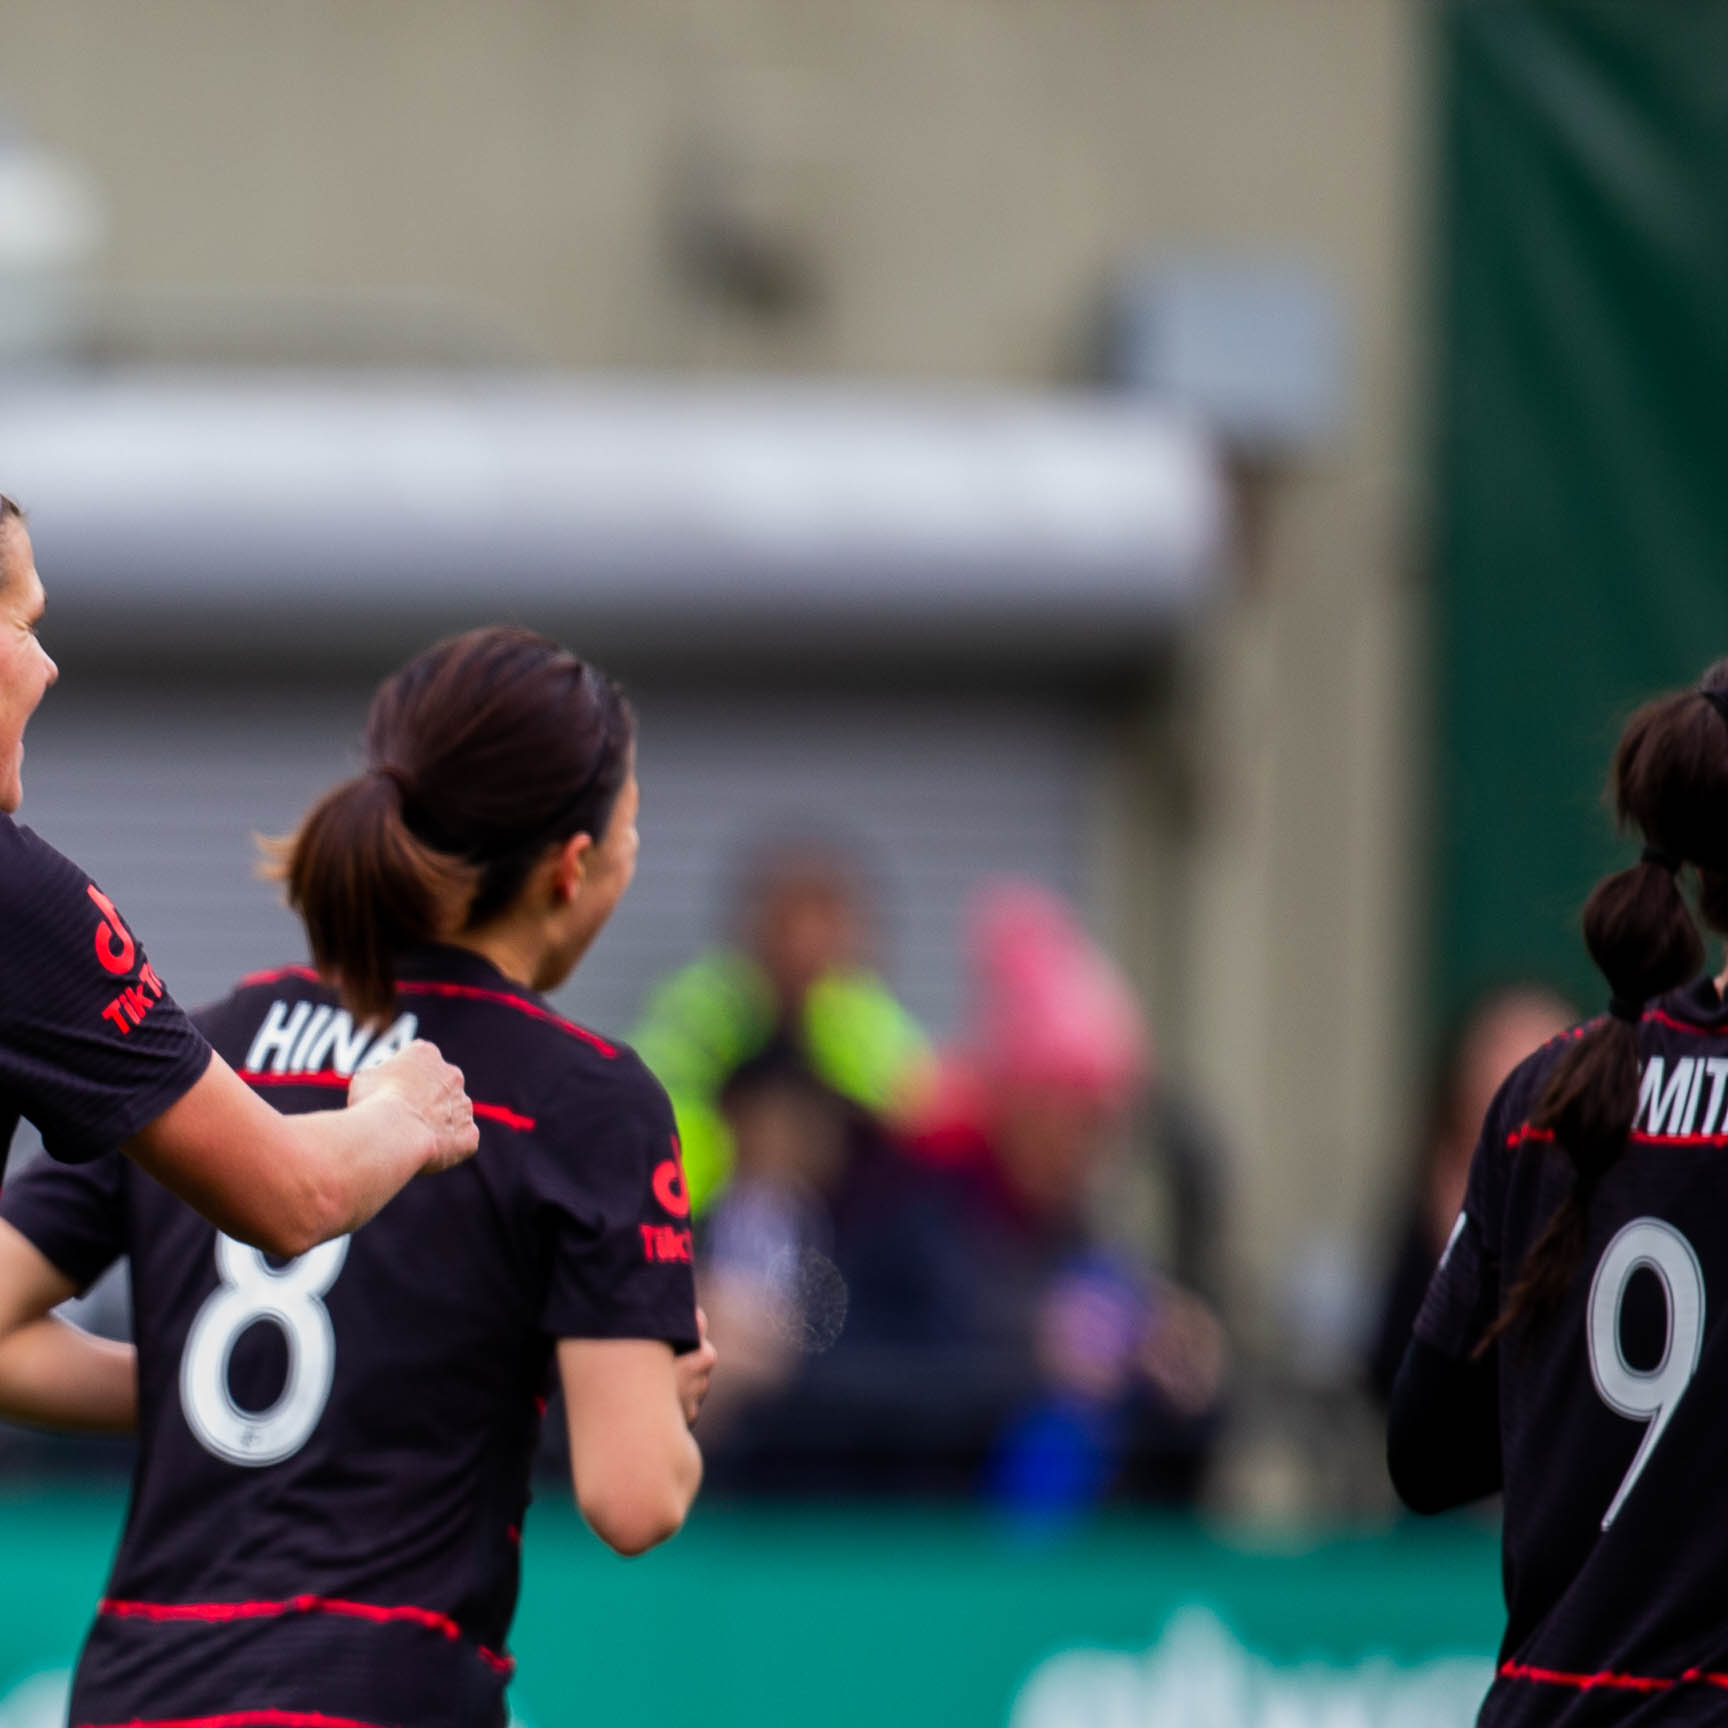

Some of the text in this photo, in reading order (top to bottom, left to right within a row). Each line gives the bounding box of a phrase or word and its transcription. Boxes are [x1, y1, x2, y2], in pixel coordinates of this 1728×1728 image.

[245, 999, 419, 1079] HINA
[1630, 1055, 1728, 1138] MIT
[180, 1228, 352, 1468] 8
[1586, 1216, 1706, 1533] 9
